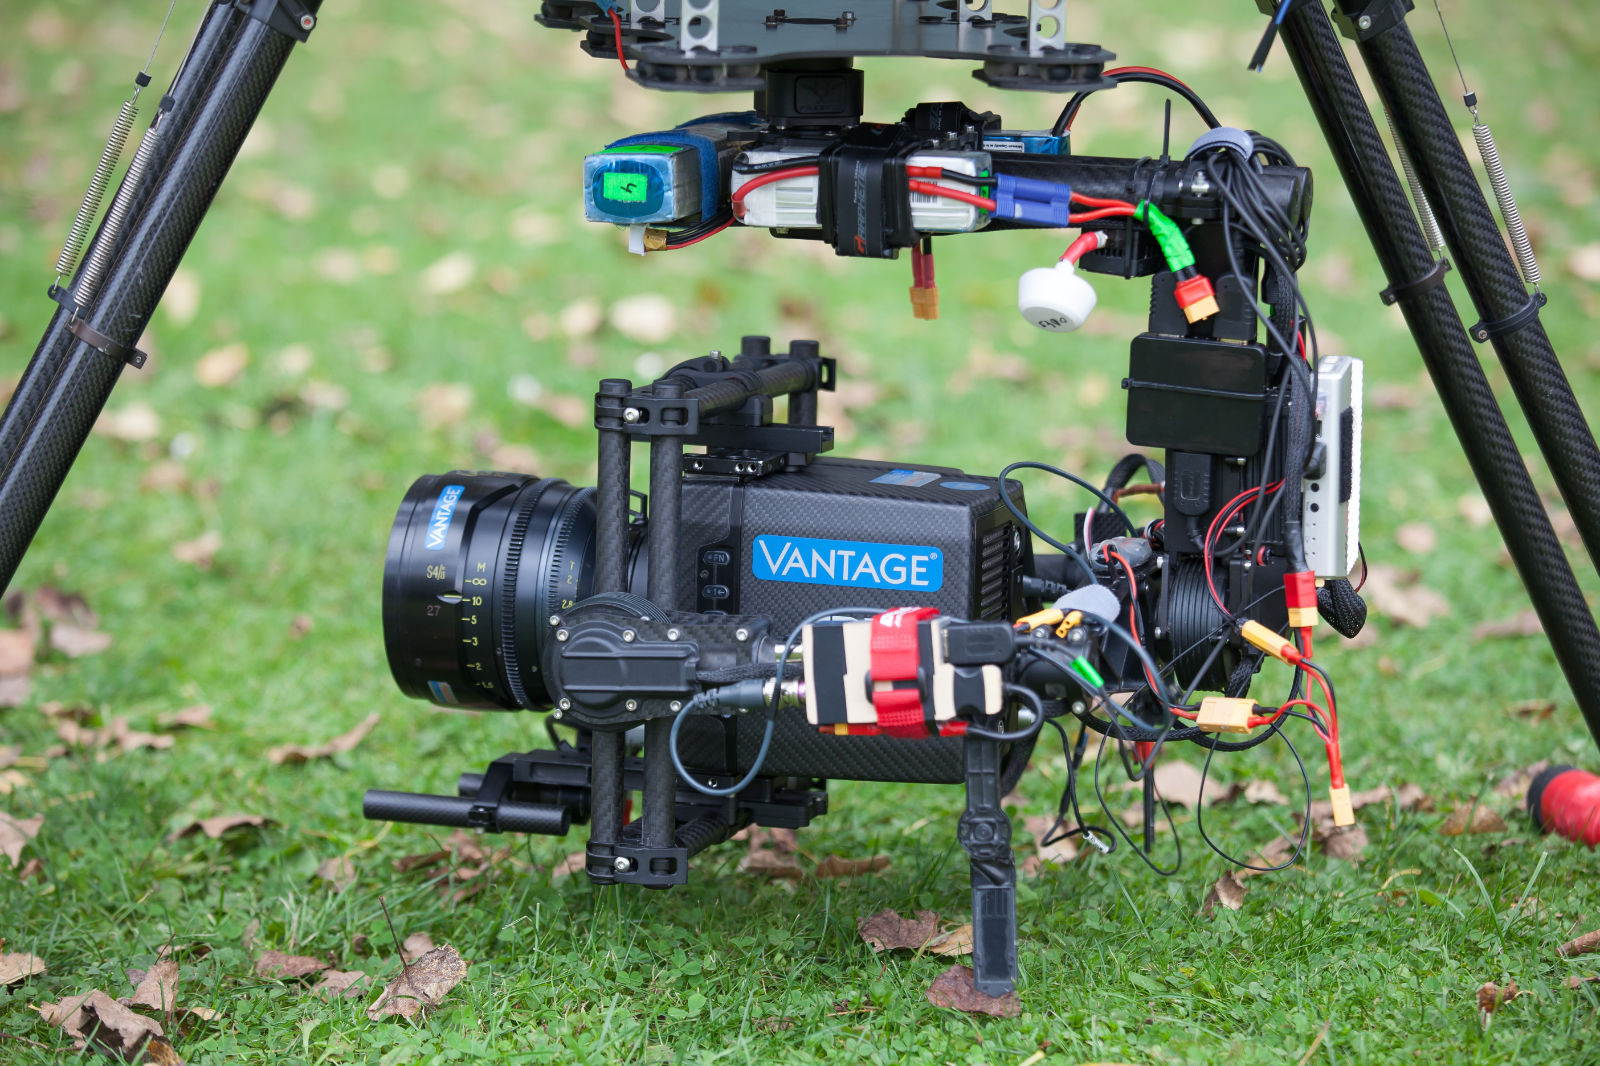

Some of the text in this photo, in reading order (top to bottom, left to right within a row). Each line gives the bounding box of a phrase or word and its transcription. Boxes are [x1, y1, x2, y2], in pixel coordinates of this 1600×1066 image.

[426, 487, 462, 549] VANTAGE
[476, 562, 486, 573] M
[566, 574, 573, 585] 2
[472, 596, 483, 606] 10
[426, 605, 441, 617] 27
